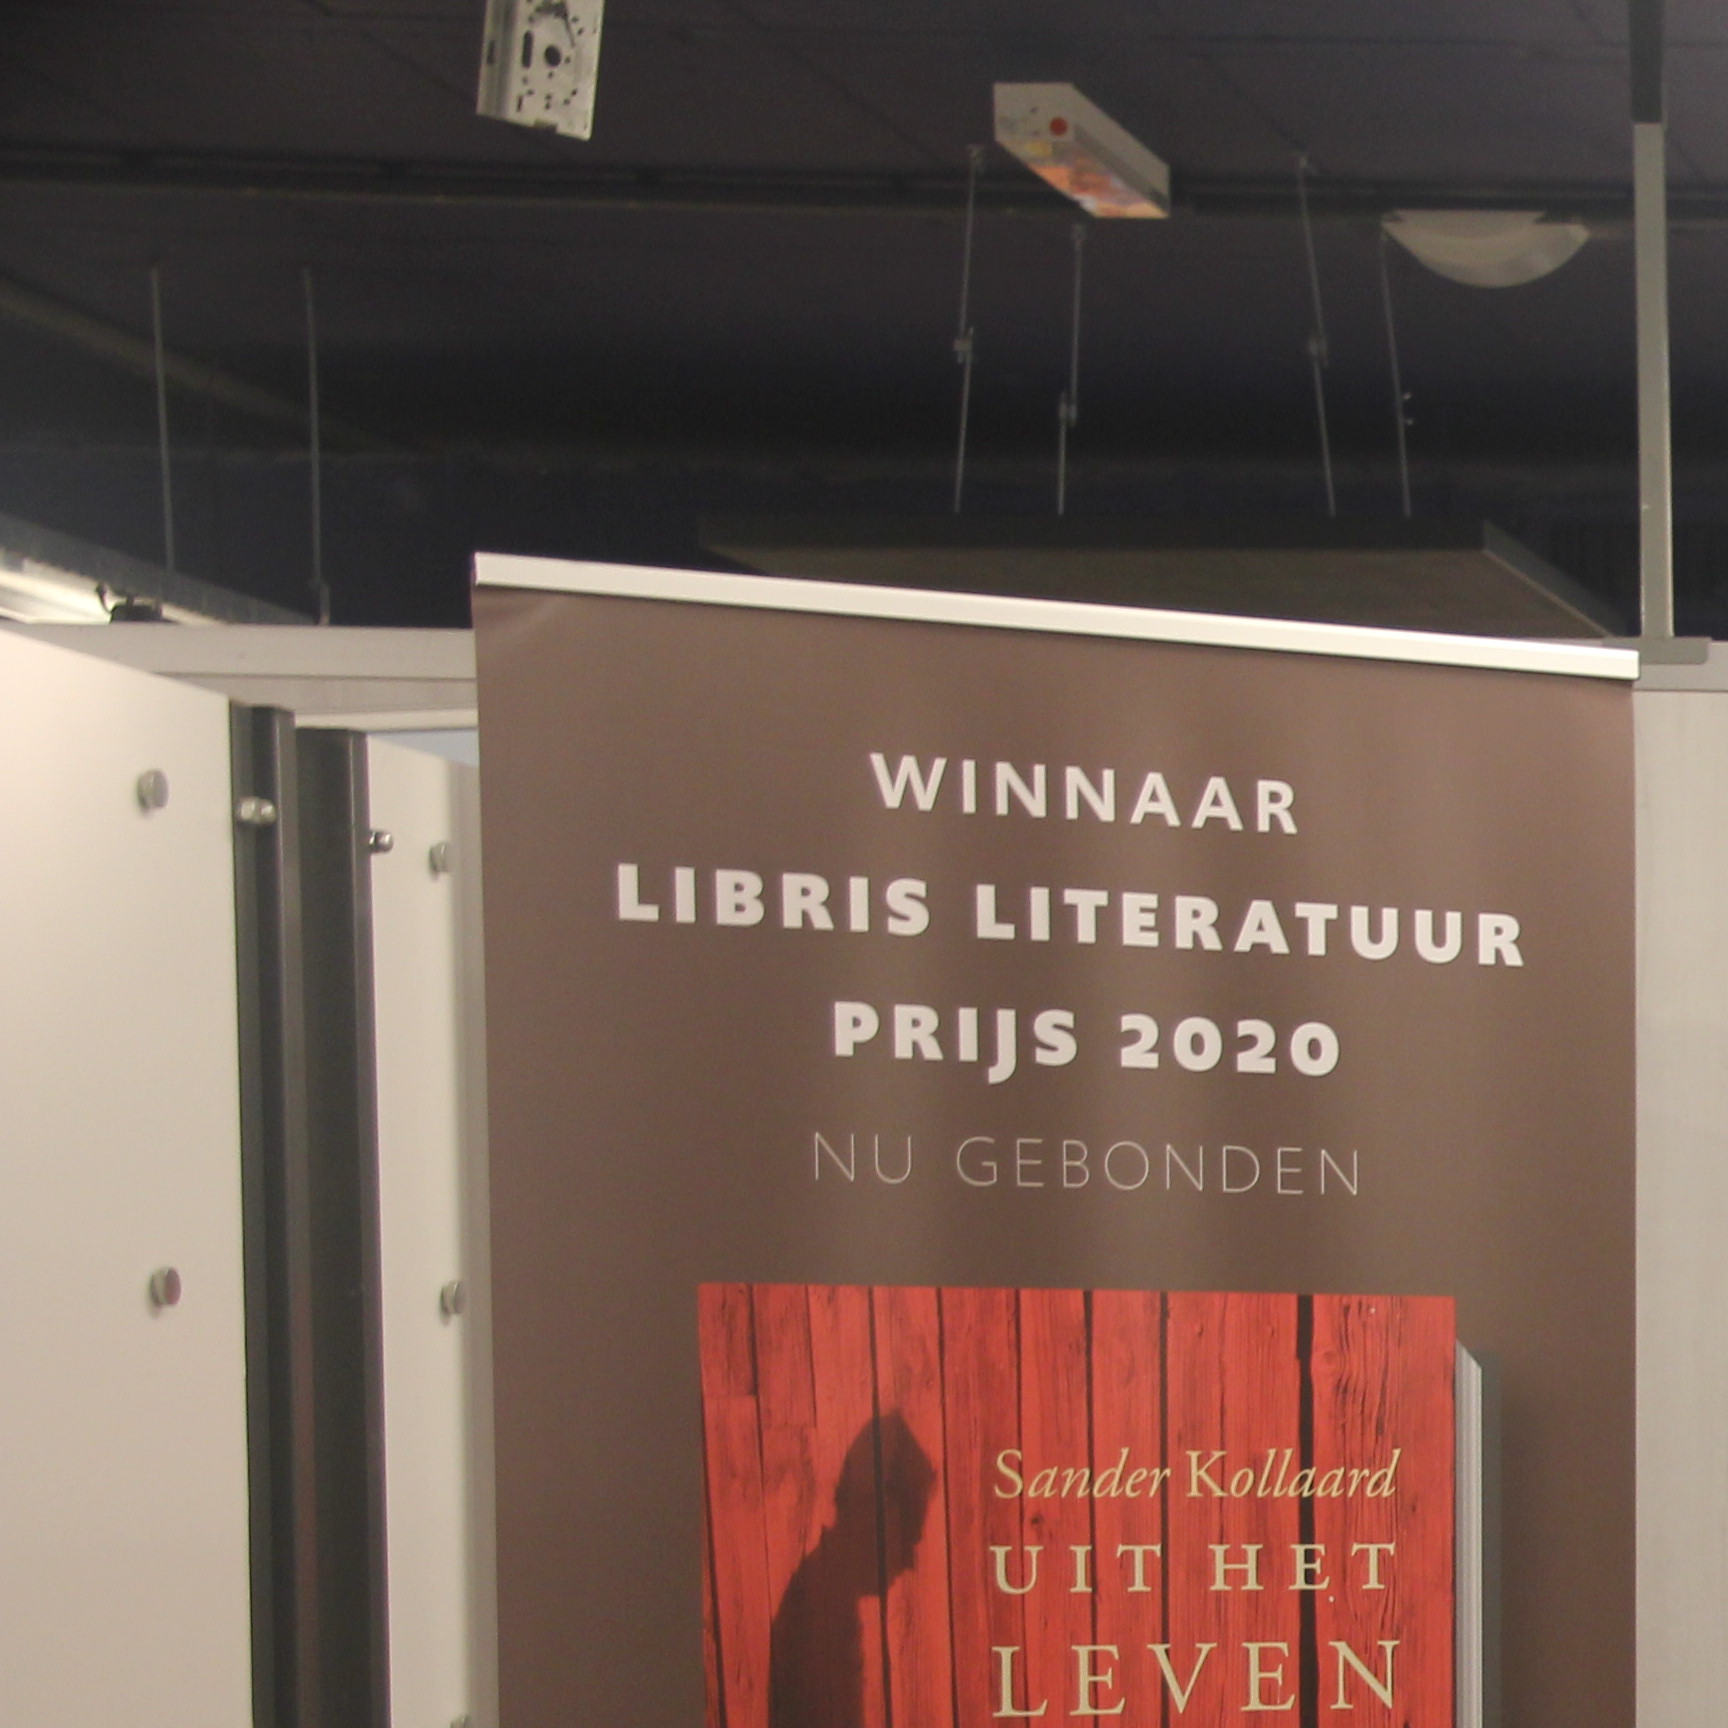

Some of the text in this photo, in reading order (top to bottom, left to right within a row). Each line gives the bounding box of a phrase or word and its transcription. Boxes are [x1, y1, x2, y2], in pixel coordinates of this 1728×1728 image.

[870, 752, 1298, 835] WINNAAR
[617, 863, 1525, 968] LIBRIS LITERATUUR
[834, 1001, 1340, 1085] PRIJS 2020
[813, 1132, 1361, 1197] NU GEBONDEN
[994, 1448, 1402, 1499] Sander Kollaard
[989, 1543, 1396, 1595] UIT HET
[991, 1640, 1401, 1718] LEVEN
